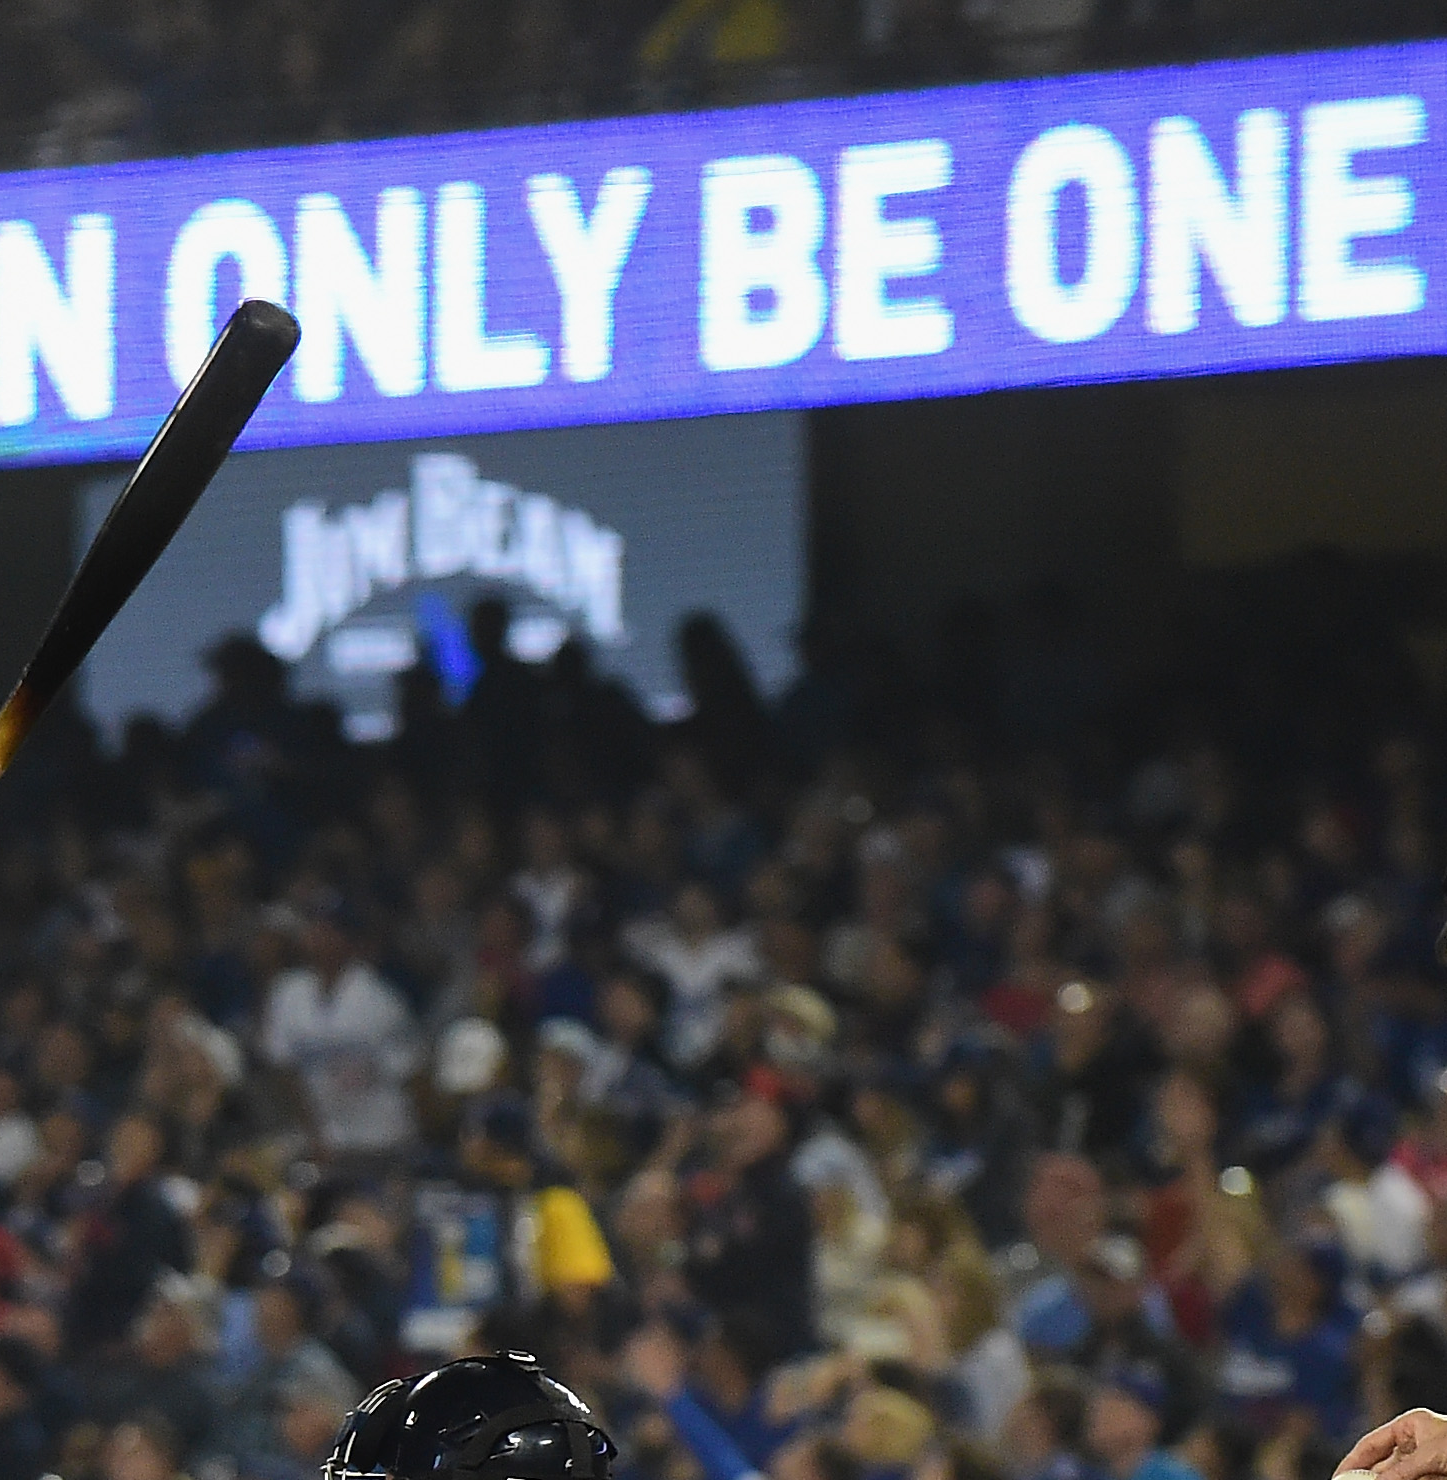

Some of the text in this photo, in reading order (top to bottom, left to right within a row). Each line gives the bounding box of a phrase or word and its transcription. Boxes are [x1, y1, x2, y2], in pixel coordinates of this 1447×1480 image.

[165, 165, 653, 405] ONLY
[699, 137, 955, 373] BE
[1003, 94, 1429, 344] ONE
